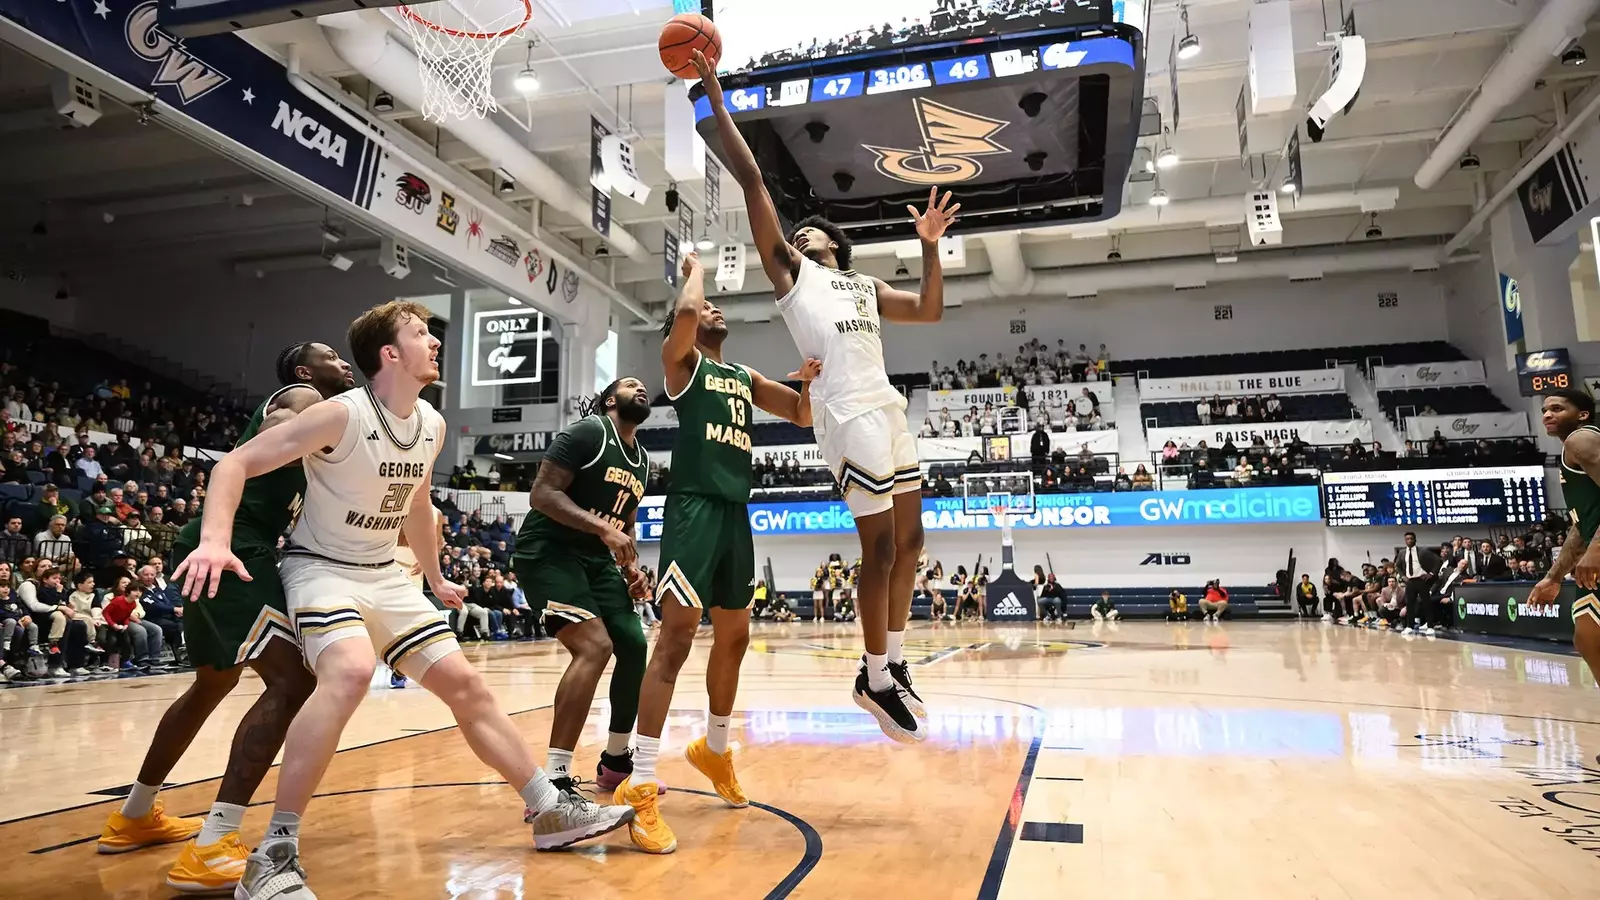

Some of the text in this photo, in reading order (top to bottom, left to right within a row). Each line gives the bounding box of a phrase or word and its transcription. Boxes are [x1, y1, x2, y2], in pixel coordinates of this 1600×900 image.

[874, 65, 925, 85] 3:06
[949, 60, 979, 79] 46
[824, 78, 851, 96] 47
[271, 99, 348, 167] NCAA
[861, 97, 1012, 185] GW
[396, 189, 425, 215] SJU
[831, 280, 873, 296] GEORGE
[1378, 298, 1398, 308] 222
[1214, 309, 1232, 320] 221
[486, 318, 530, 332] ONLY
[835, 319, 880, 338] WASHIN
[1010, 325, 1026, 334] 220
[500, 332, 516, 344] AT
[705, 374, 752, 404] GEORG
[1238, 379, 1263, 390] THE
[1269, 376, 1302, 388] BLUE
[1532, 374, 1568, 390] 8:48
[964, 393, 1010, 404] FOUNDE
[1042, 390, 1068, 400] 1821
[728, 397, 746, 426] 13
[514, 432, 546, 450] FAN
[1216, 429, 1299, 442] RAISE HIGH
[804, 450, 822, 460] HIG
[380, 462, 424, 478] GEORGE
[380, 484, 413, 512] 20
[612, 490, 630, 514] 11
[1140, 492, 1312, 521] GWmedicine
[345, 510, 408, 530] WASHINGT
[750, 506, 856, 531] GWmedic
[921, 510, 989, 529] GAME
[993, 607, 1028, 616] adidas
[1466, 603, 1500, 616] BEYOND MEAT
